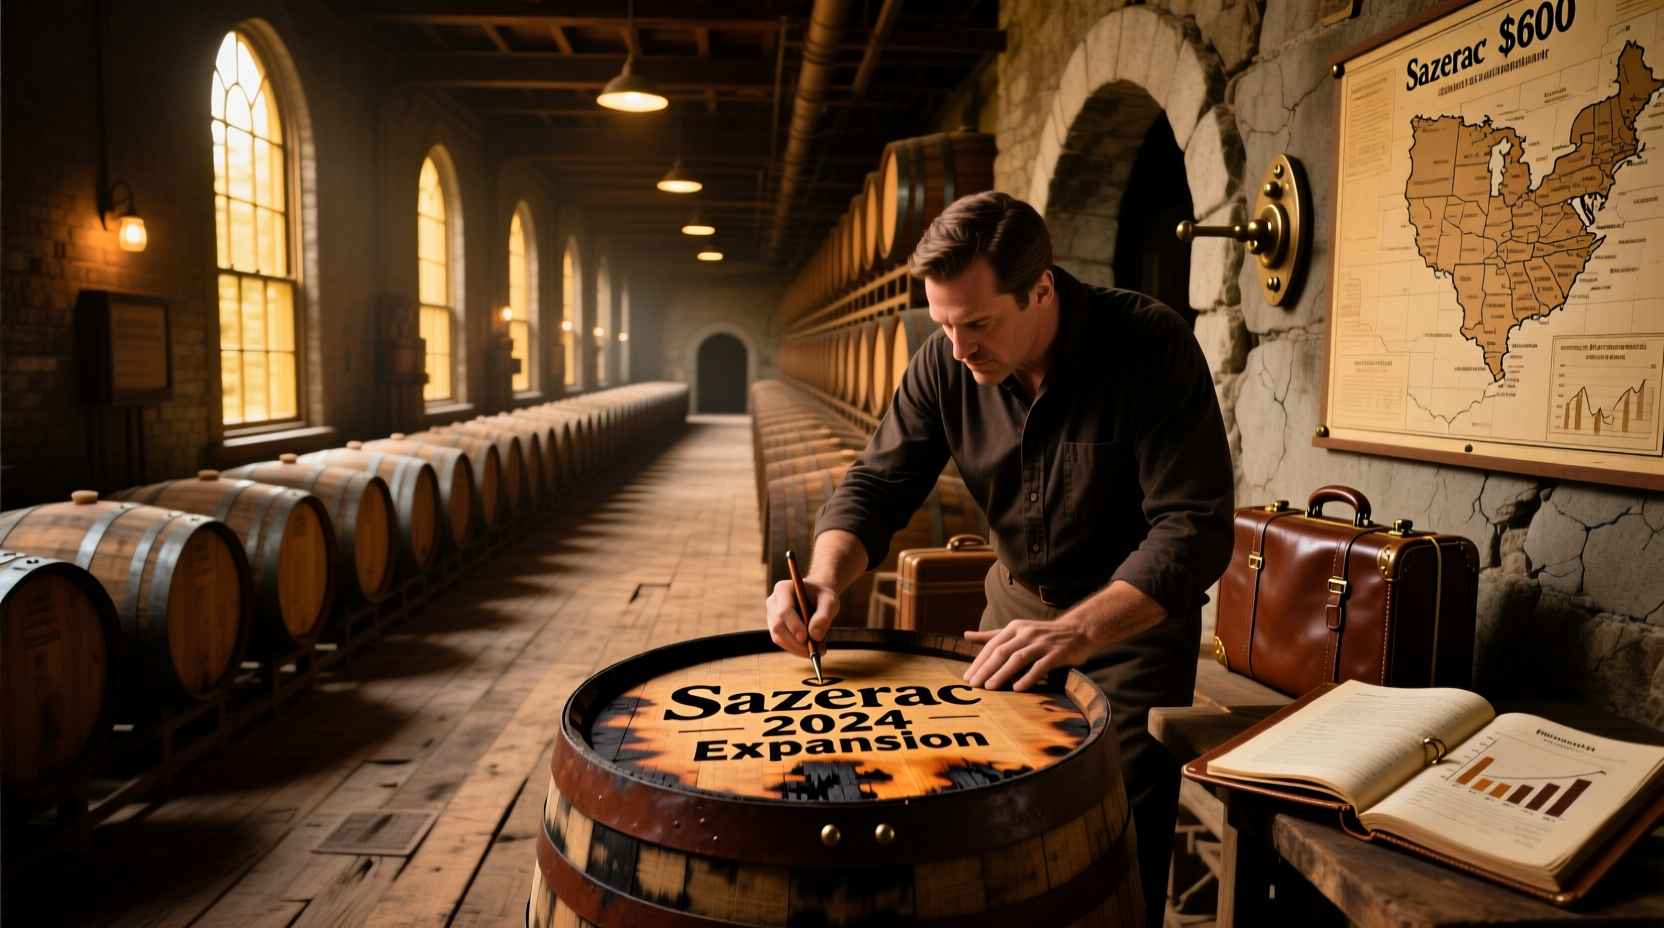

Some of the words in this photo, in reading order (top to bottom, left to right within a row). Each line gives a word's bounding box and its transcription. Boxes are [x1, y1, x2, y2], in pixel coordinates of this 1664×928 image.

[1406, 38, 1487, 91] Sazerac
[1498, 0, 1576, 58] $600
[663, 684, 982, 721] Sazerac
[762, 709, 913, 737] 2024
[693, 731, 990, 762] Expansion
